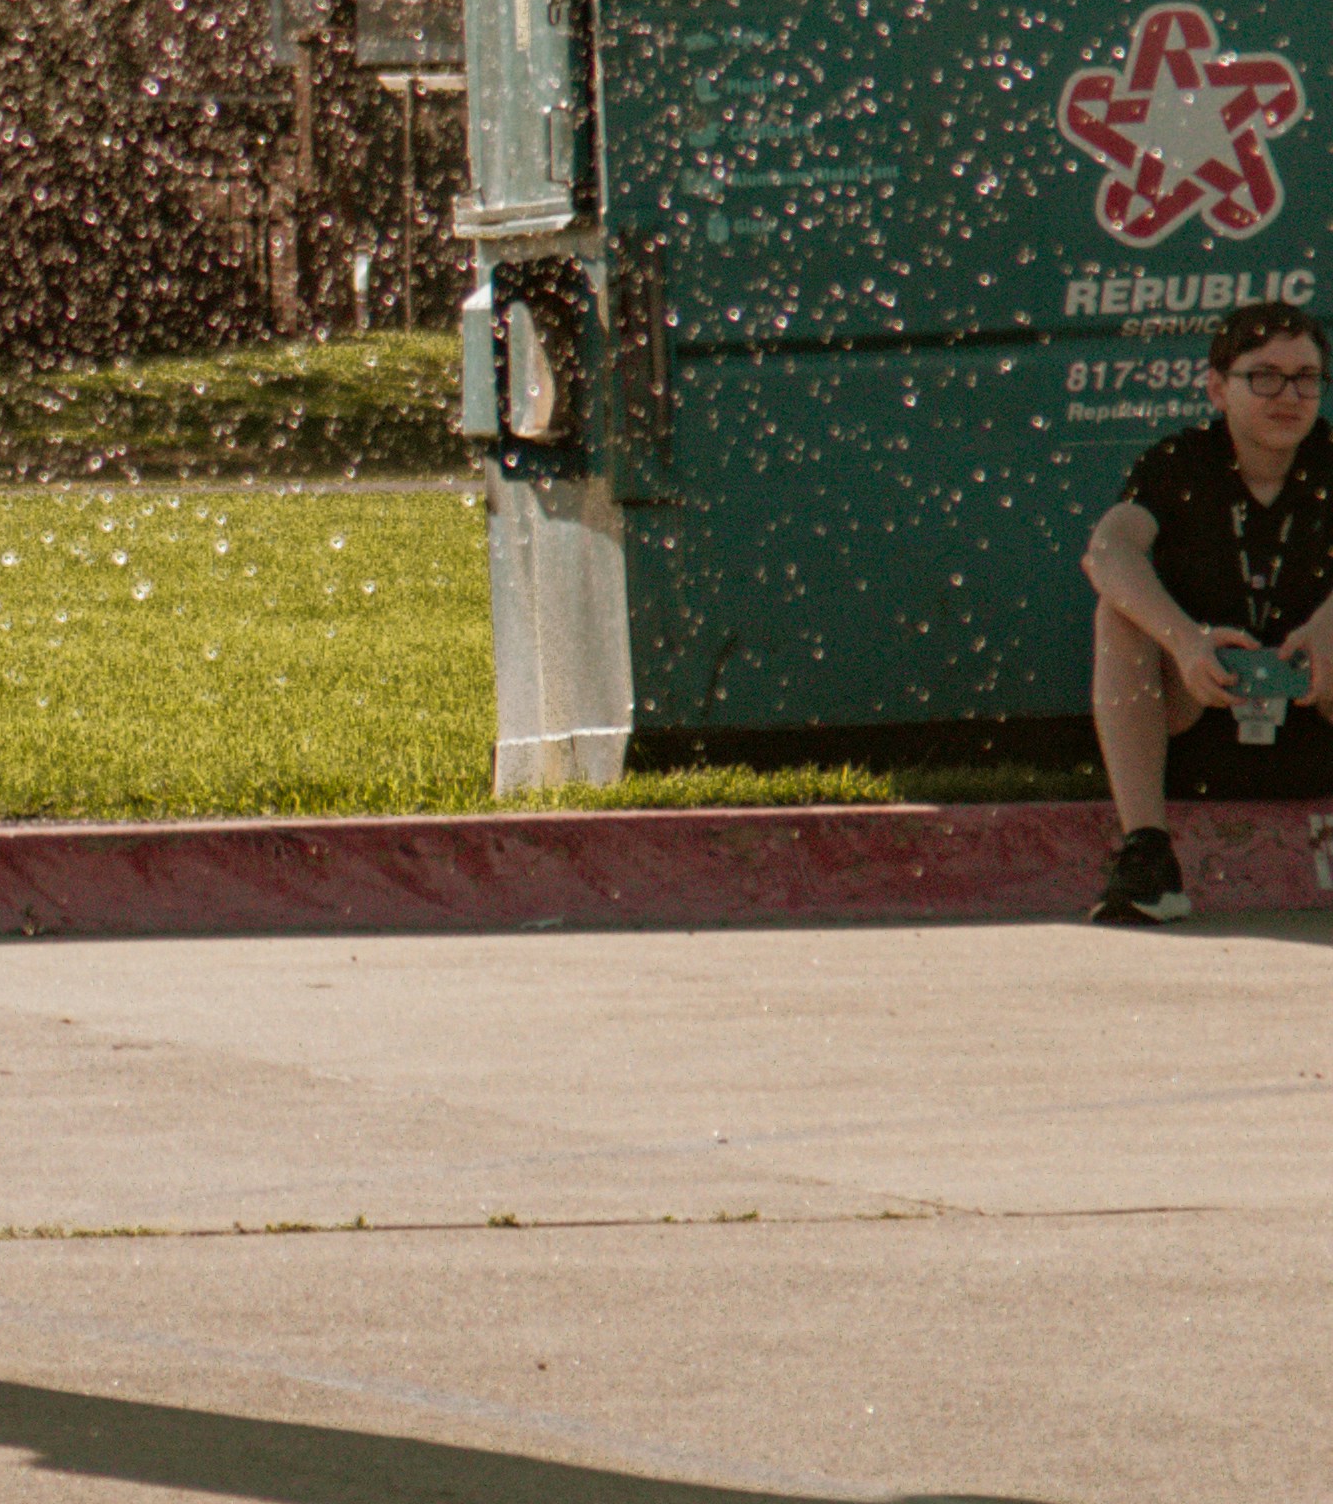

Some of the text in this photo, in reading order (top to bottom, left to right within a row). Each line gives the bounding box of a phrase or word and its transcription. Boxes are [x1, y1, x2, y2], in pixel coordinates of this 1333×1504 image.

[1065, 269, 1315, 315] REPUBLIC
[1121, 315, 1223, 336] SERVIC
[1066, 358, 1210, 391] 817-332
[1067, 397, 1216, 423] RepublicServ
